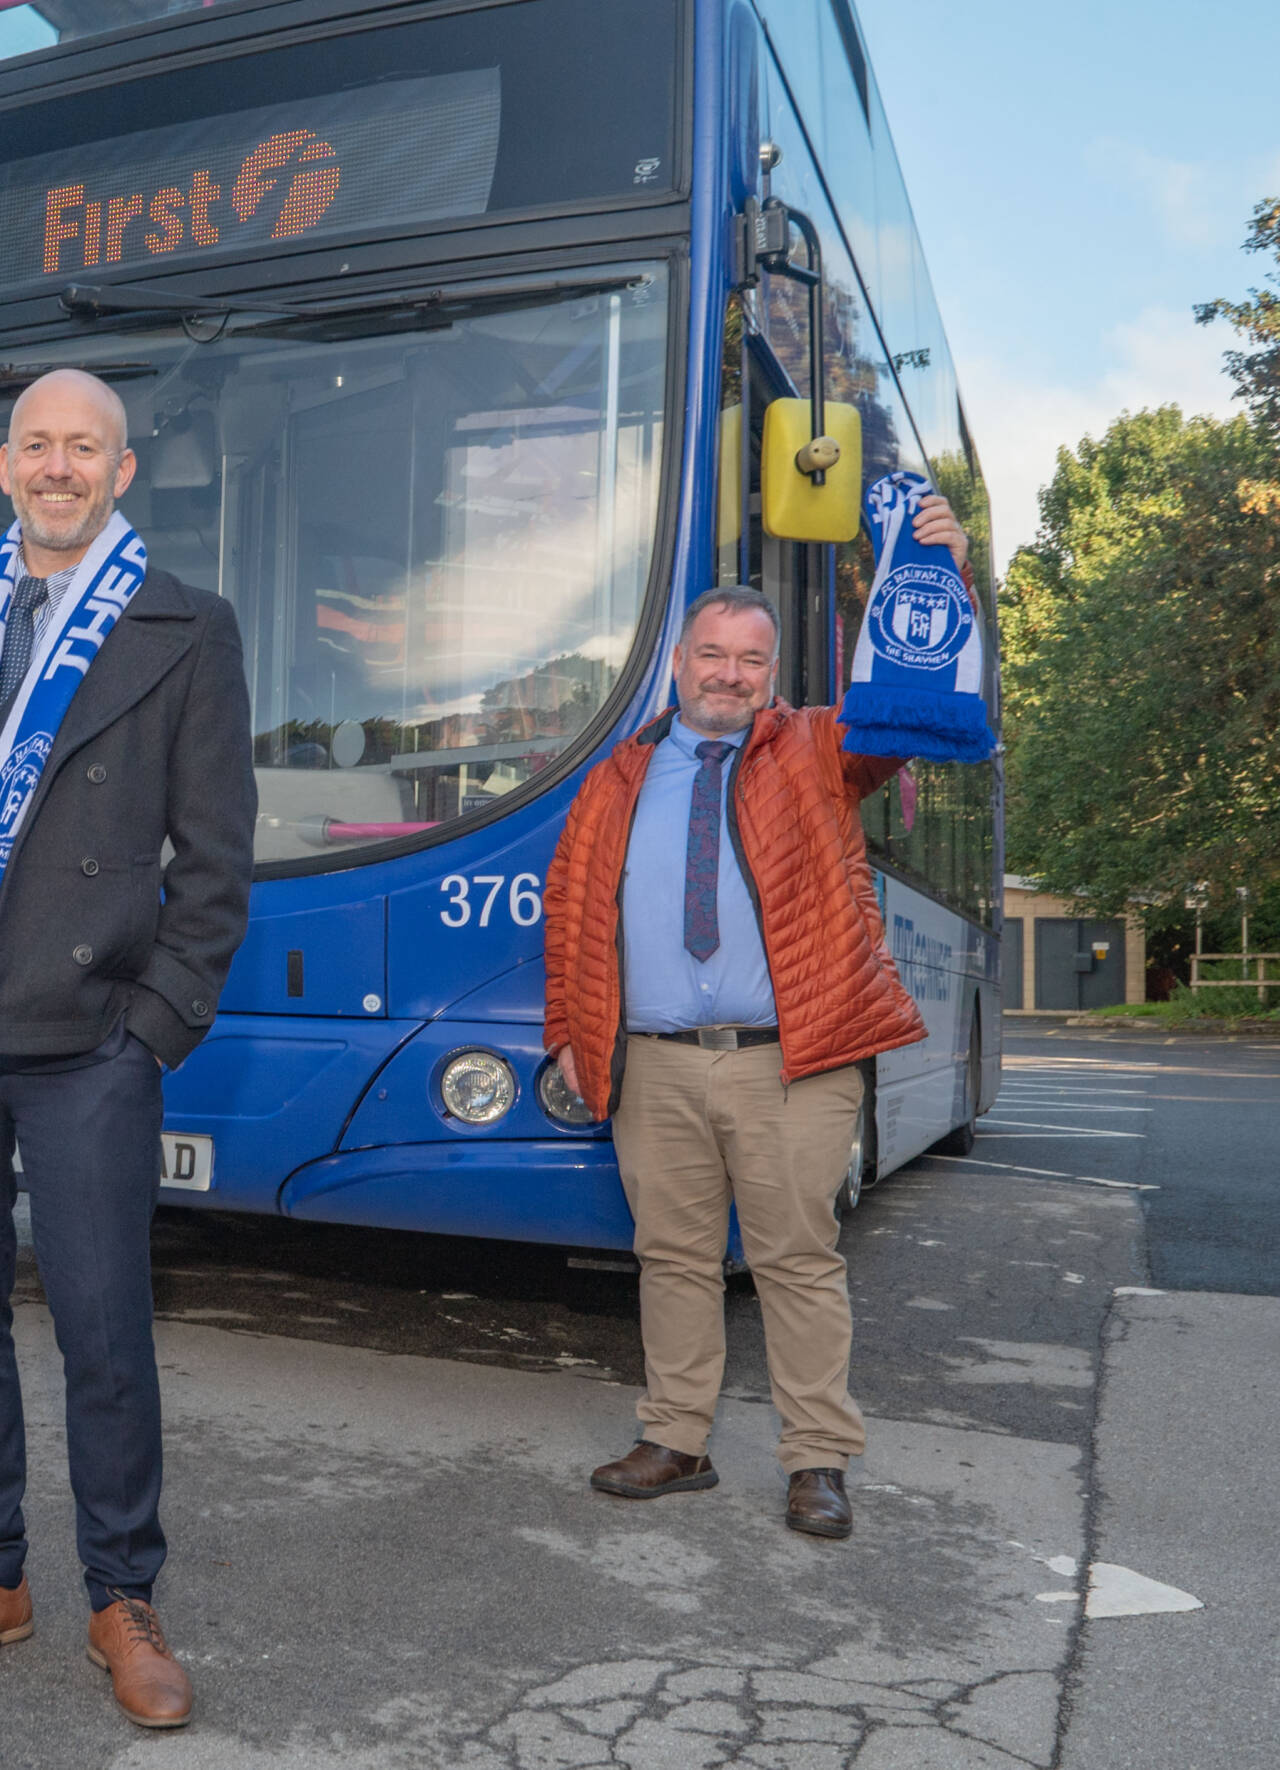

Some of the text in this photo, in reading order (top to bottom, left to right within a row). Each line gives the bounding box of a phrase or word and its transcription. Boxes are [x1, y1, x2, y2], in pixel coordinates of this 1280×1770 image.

[43, 169, 220, 273] First
[940, 575, 969, 603] TOWN
[440, 873, 542, 928] 376
[161, 1143, 196, 1181] D
